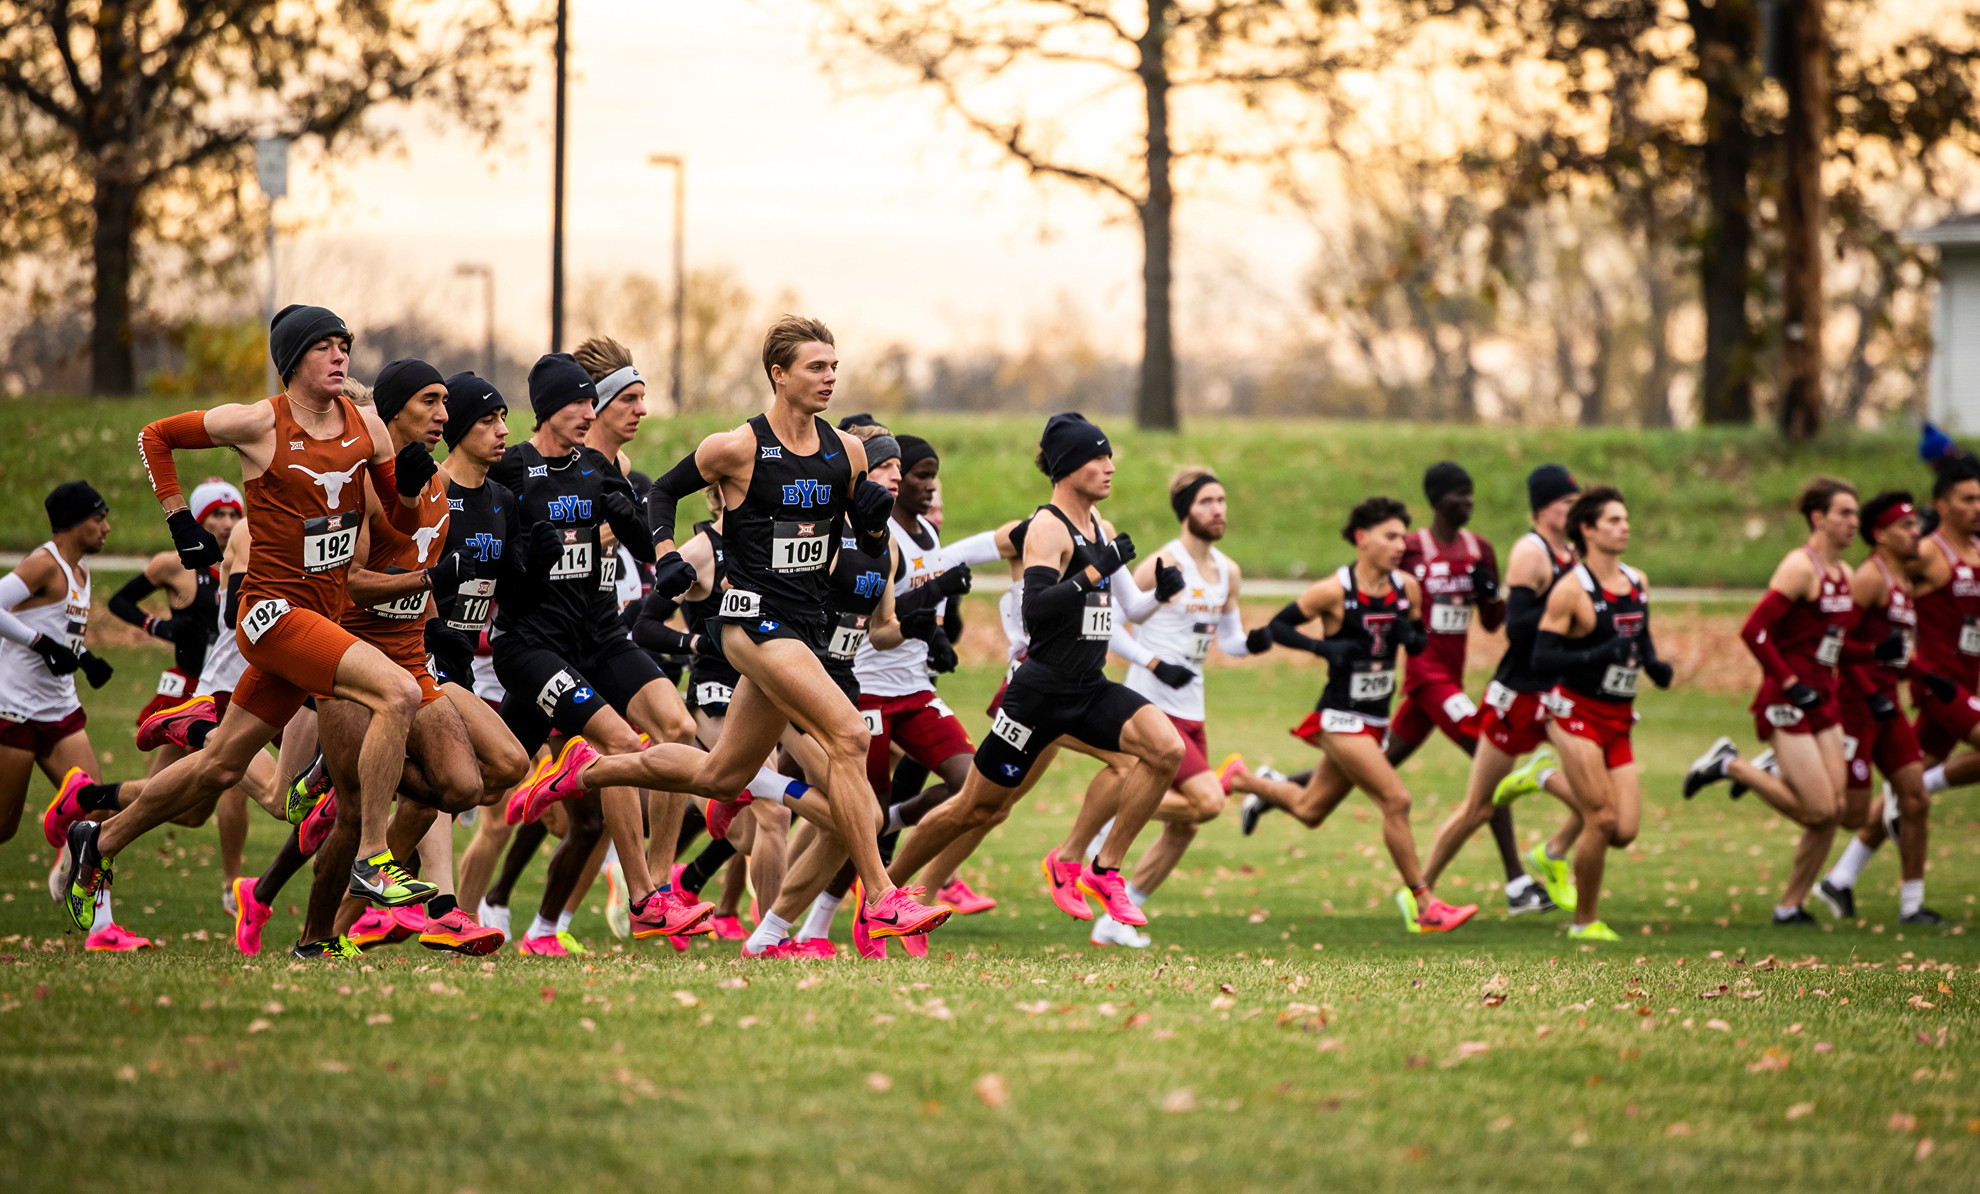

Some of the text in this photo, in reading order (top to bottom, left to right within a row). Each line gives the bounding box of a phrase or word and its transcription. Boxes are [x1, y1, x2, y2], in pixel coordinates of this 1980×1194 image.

[782, 479, 832, 508] BYU
[548, 495, 592, 522] BYU
[316, 533, 350, 561] 192
[785, 541, 822, 563] 109
[248, 601, 282, 632] 192
[463, 598, 489, 621] 110
[1092, 611, 1112, 631] 115
[541, 679, 568, 710] 114
[574, 687, 591, 700] Y
[995, 716, 1022, 743] 115
[1004, 763, 1020, 777] Y
